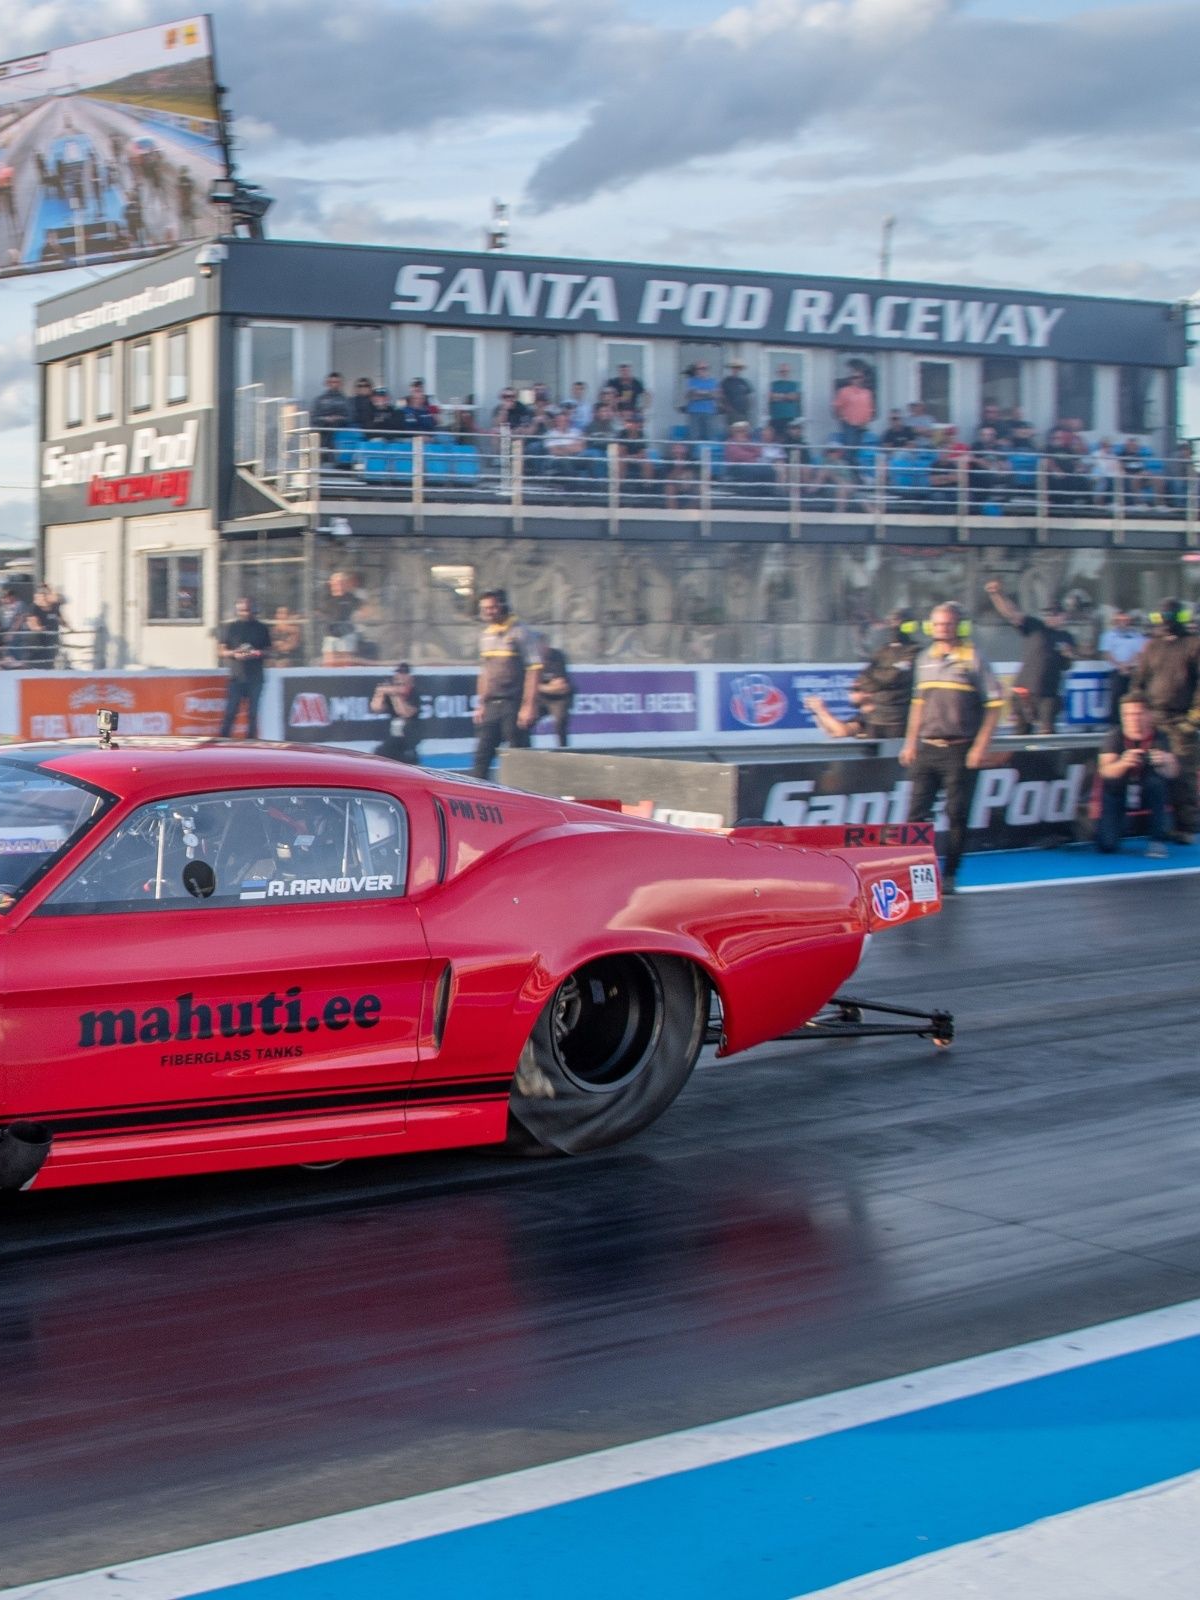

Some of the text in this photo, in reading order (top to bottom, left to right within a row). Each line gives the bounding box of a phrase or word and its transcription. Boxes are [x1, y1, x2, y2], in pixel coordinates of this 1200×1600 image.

[391, 264, 1064, 349] SANTA POD RACEWAY
[40, 419, 199, 488] Santa Pod
[331, 694, 434, 721] MILLS
[450, 800, 505, 825] PM 911
[967, 764, 1087, 829] Pod
[268, 874, 394, 898] A.ARNOVER
[78, 986, 383, 1048] mahuti.ee
[160, 1045, 305, 1067] FIBERGLASS TANKS
